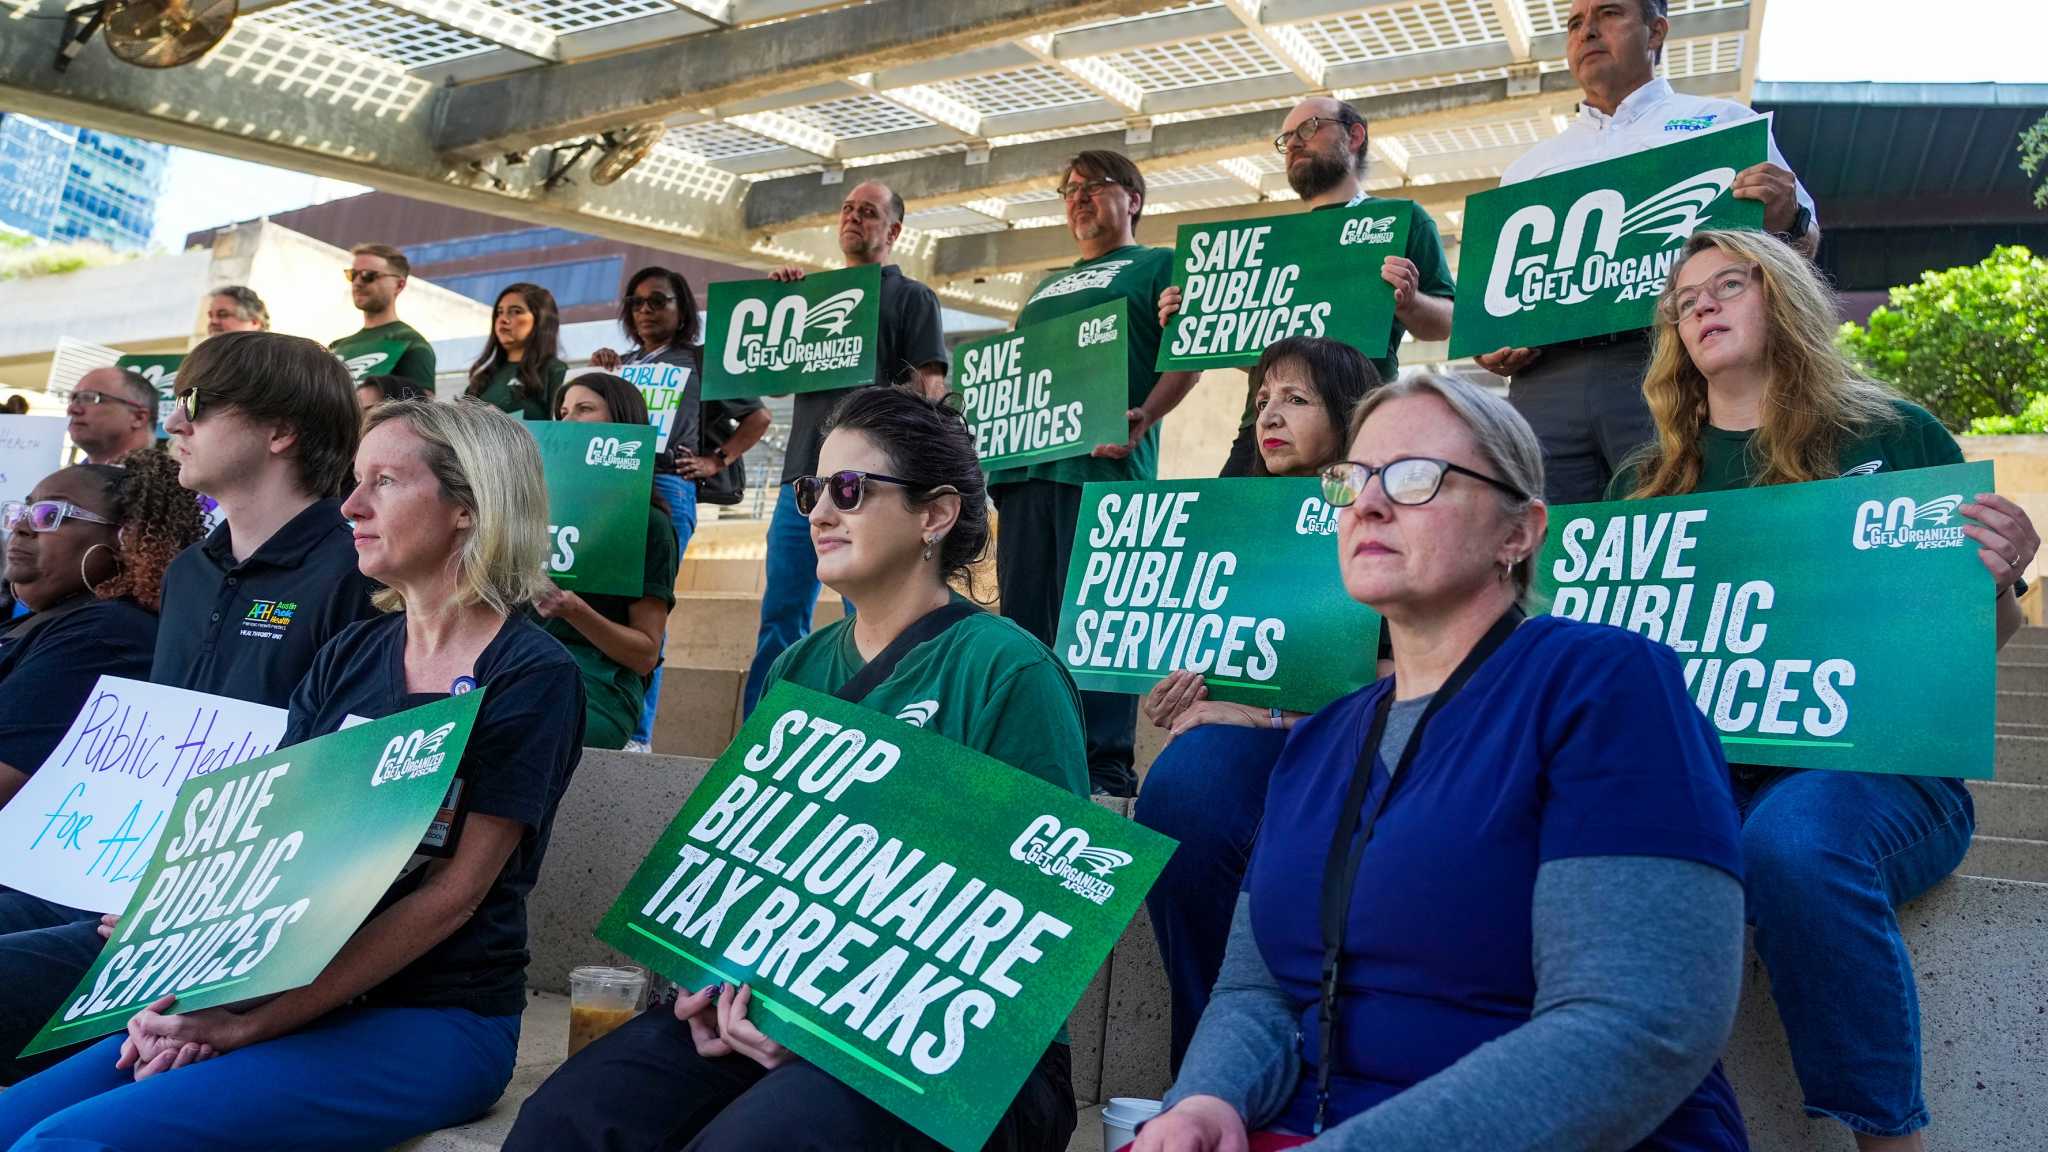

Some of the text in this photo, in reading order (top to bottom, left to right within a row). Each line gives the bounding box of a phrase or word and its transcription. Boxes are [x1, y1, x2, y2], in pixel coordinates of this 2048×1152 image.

[1185, 226, 1271, 273] SAVE
[1484, 189, 1625, 317] GO
[1179, 264, 1300, 315] PUBLIC
[1521, 266, 1573, 303] GET
[1614, 278, 1665, 303] AFS
[723, 295, 808, 375] GO
[747, 336, 862, 368] GET ORGANIZED
[622, 367, 681, 388] PUBLIC
[802, 355, 859, 373] AFSCME
[961, 337, 1025, 387] SAVE
[963, 369, 1052, 421] PUBLIC
[1089, 492, 1200, 548] SAVE
[1308, 518, 1325, 532] GET
[1553, 509, 1708, 583] SAVE
[1853, 497, 1916, 550] GO
[1871, 526, 1965, 545] GET ORGANIZED
[1915, 540, 1964, 550] AFSCME
[276, 601, 297, 610] Austin
[1076, 551, 1236, 610] PUBLIC
[247, 603, 274, 619] APH
[1067, 610, 1285, 681] SERVICES
[62, 691, 164, 779] Public
[371, 729, 425, 787] GO
[743, 709, 901, 802] STOP
[165, 763, 290, 863] SAVE
[1010, 814, 1090, 876] GO
[1025, 844, 1115, 898] GET ORGANIZED
[119, 830, 304, 943] PUBLIC
[688, 774, 1073, 999] BILLIONAIRE
[1059, 880, 1107, 906] AFSCME
[63, 899, 310, 1022] SERVICES
[640, 845, 997, 1075] TAX BREAKS
